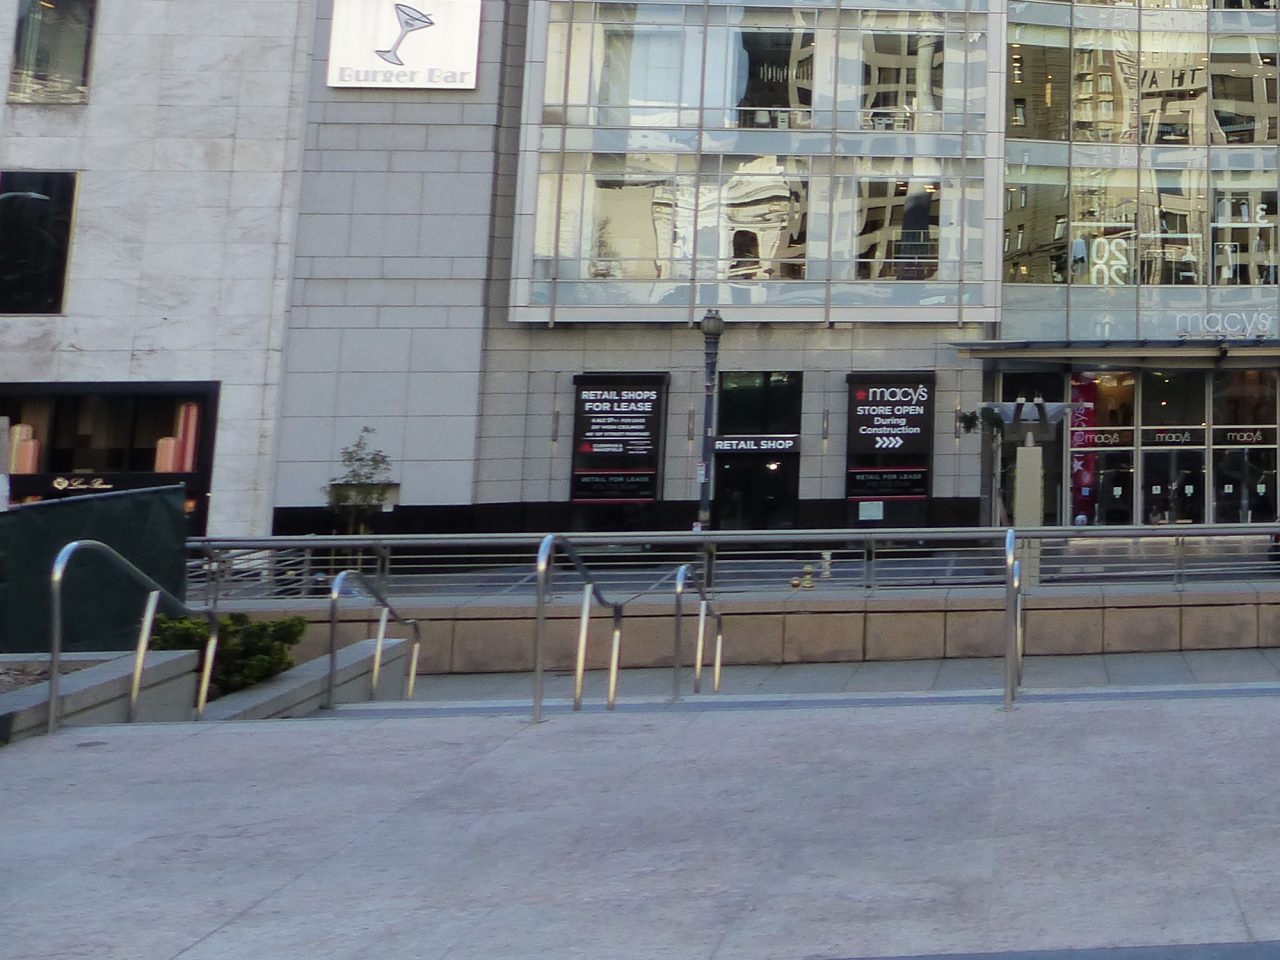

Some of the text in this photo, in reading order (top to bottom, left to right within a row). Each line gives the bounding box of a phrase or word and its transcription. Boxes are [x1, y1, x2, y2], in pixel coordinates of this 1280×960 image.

[338, 66, 471, 84] Burger Bar
[581, 391, 657, 400] RETAIL SHOPS
[869, 384, 928, 405] macy's
[585, 402, 653, 411] FOR LEASE
[856, 406, 924, 415] STORE OPEN
[874, 417, 907, 426] During
[859, 426, 921, 434] Construction
[715, 440, 794, 450] RETAIL SHOP
